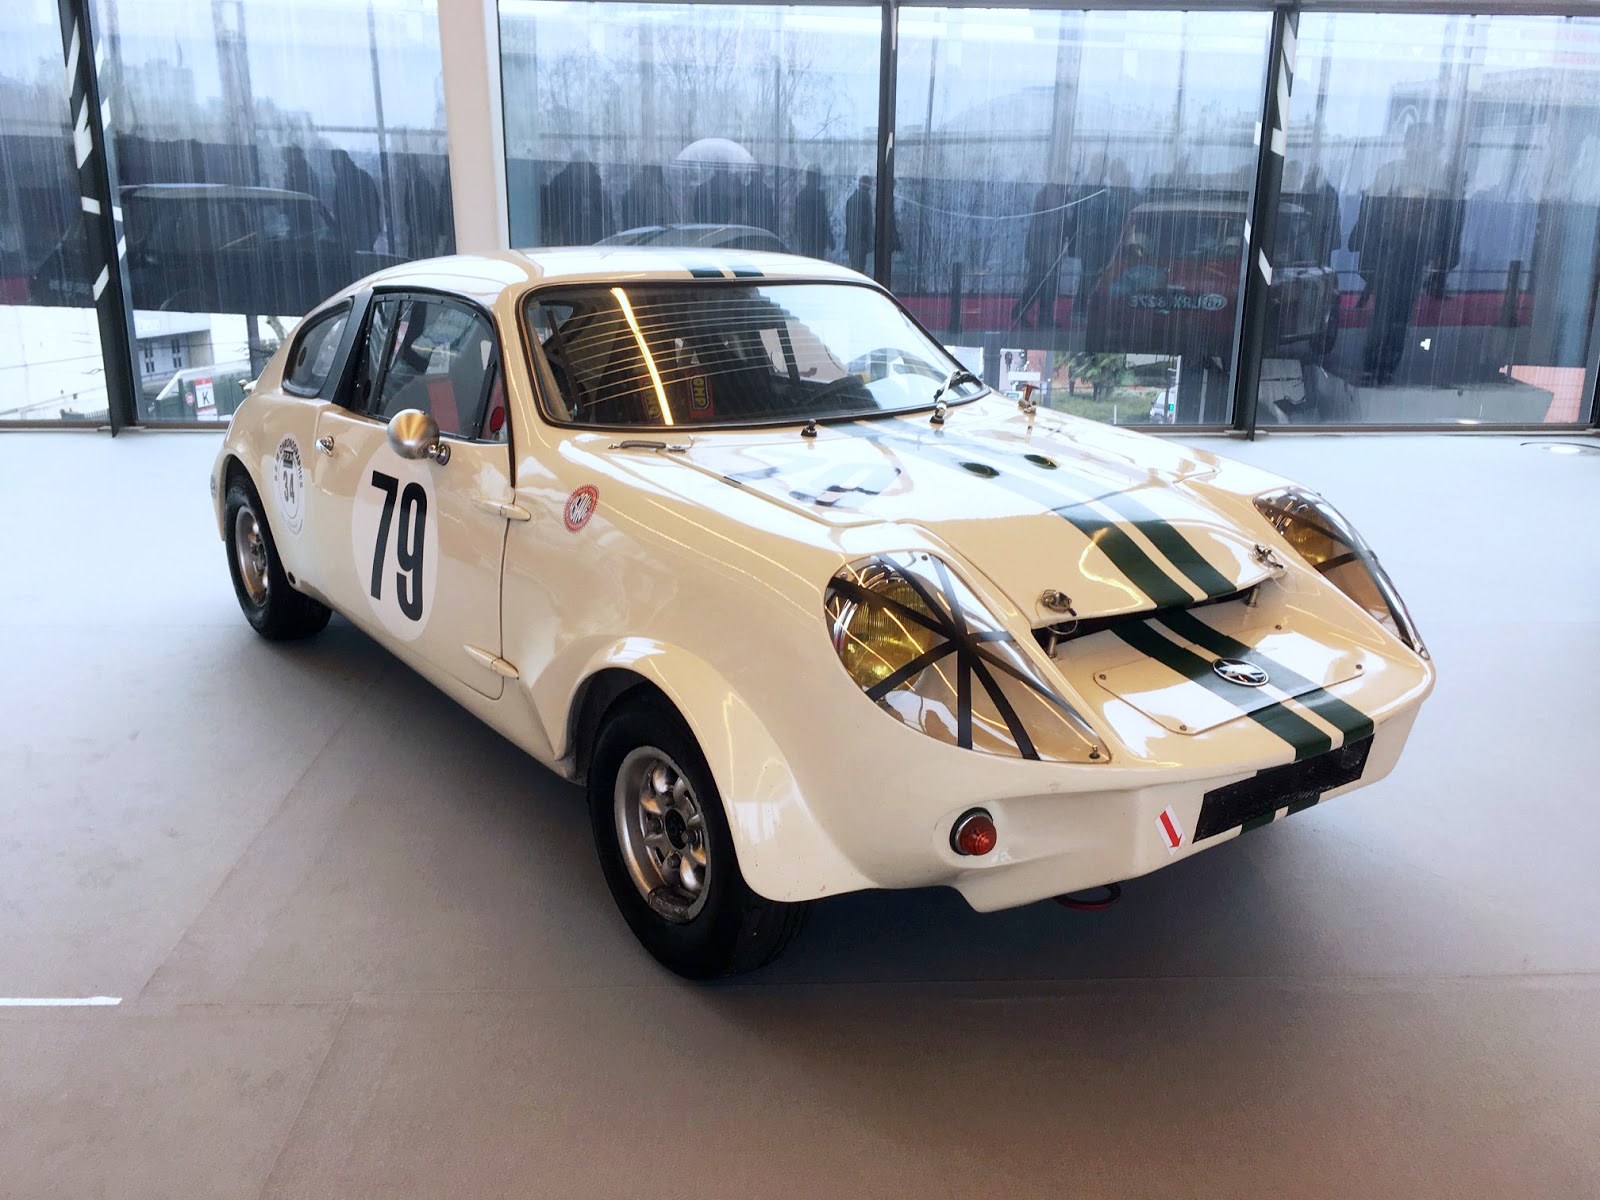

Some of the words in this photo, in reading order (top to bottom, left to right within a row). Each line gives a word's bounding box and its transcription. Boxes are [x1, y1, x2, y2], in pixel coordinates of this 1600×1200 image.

[202, 391, 210, 405] K
[693, 378, 706, 406] OMP
[283, 470, 295, 504] 34
[370, 470, 427, 621] 79
